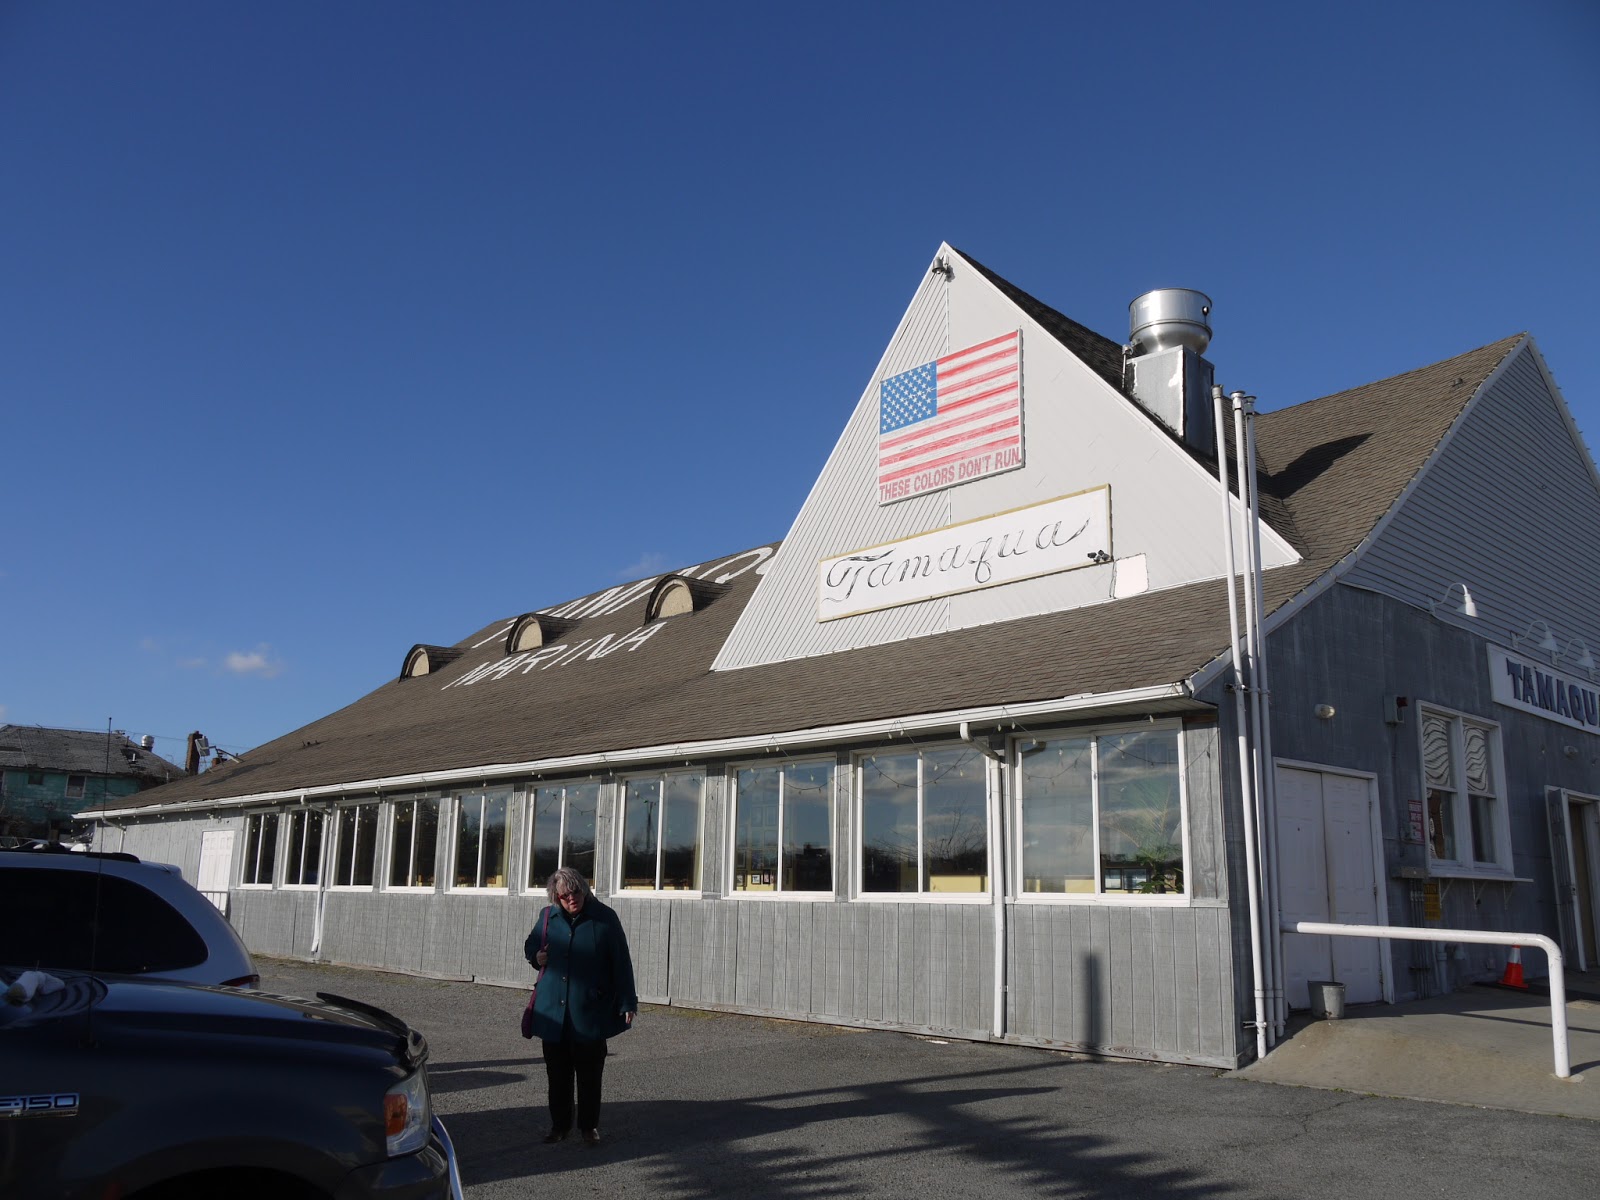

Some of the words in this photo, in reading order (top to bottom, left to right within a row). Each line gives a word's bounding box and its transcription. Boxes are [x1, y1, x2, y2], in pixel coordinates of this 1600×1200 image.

[879, 478, 910, 501] THESE
[914, 466, 955, 492] COLORS
[958, 455, 992, 480] DON'T
[822, 517, 1091, 602] Tamaqua
[440, 621, 667, 691] MARINA
[1505, 657, 1600, 728] TAMAQU
